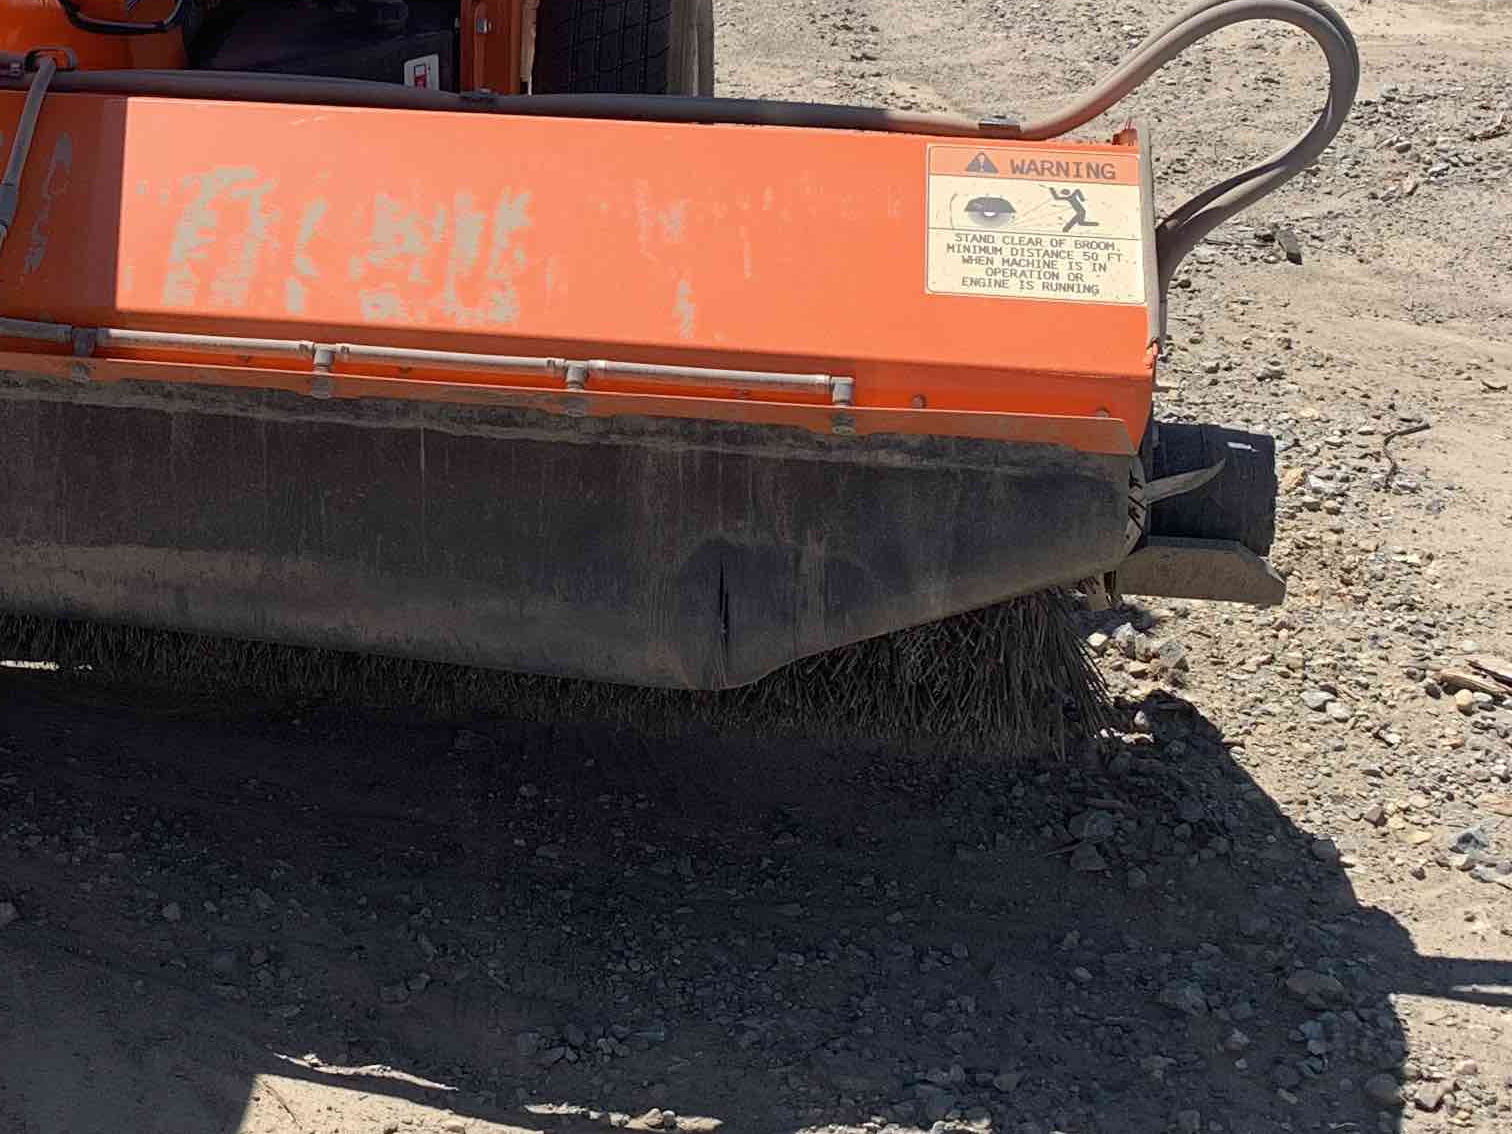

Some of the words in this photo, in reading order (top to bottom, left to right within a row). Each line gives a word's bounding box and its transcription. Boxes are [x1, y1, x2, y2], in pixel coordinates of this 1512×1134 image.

[1010, 158, 1117, 180] WARNING
[954, 233, 995, 244] STAND
[1002, 235, 1042, 246] CLEAR
[1050, 239, 1066, 247] OF
[946, 243, 1002, 255] MINIMUM
[1010, 247, 1073, 260] DISTANCE
[1083, 251, 1099, 261] 50
[962, 255, 994, 266] WHEN
[1001, 257, 1058, 270] MACHINE
[1068, 261, 1083, 271] IS
[1092, 262, 1107, 273] IN
[985, 267, 1060, 281] OPERATION
[1068, 272, 1084, 282] OR
[961, 276, 1009, 289] ENGINE
[1019, 280, 1035, 290] IS
[1042, 282, 1100, 295] RUNNING
